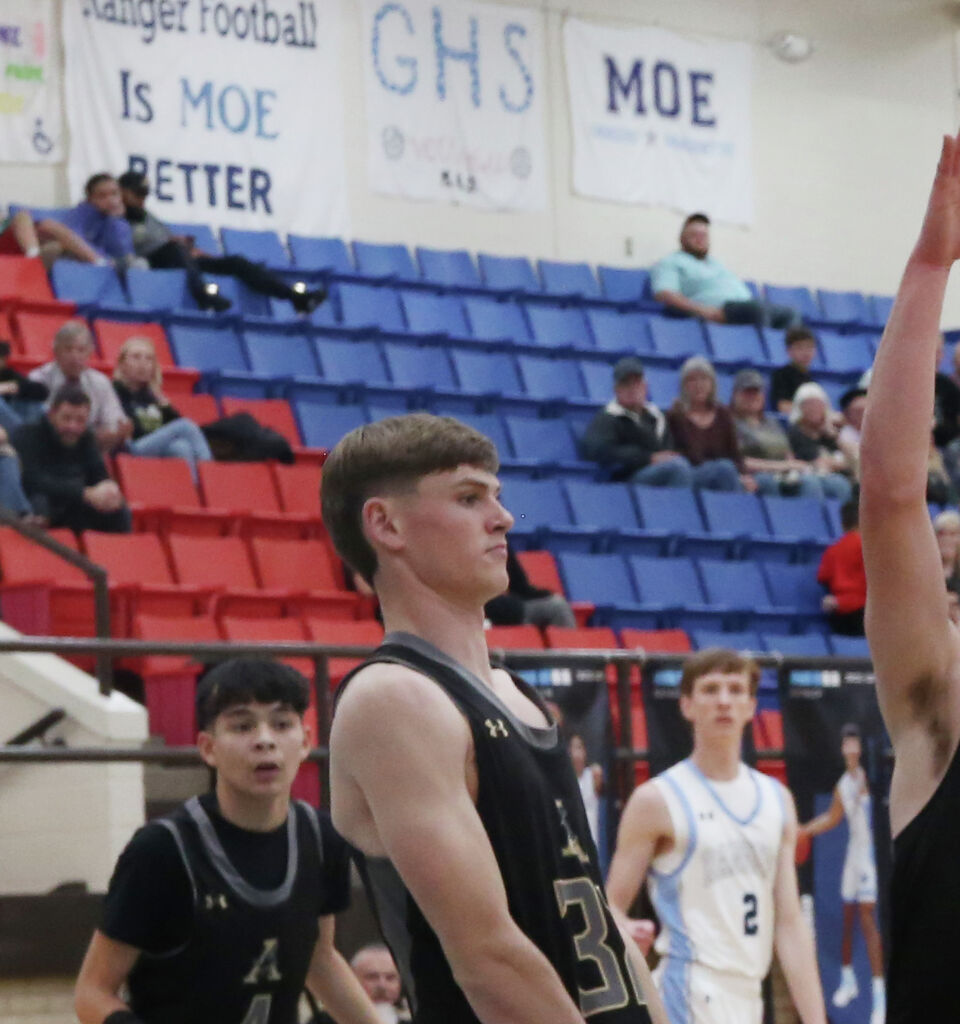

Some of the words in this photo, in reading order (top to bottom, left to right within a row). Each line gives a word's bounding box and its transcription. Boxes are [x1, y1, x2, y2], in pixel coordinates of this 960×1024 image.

[371, 3, 535, 114] GHS
[604, 54, 717, 128] MOE
[120, 70, 154, 124] Is
[181, 77, 279, 140] MOE
[743, 893, 759, 936] 2
[243, 938, 282, 985] A
